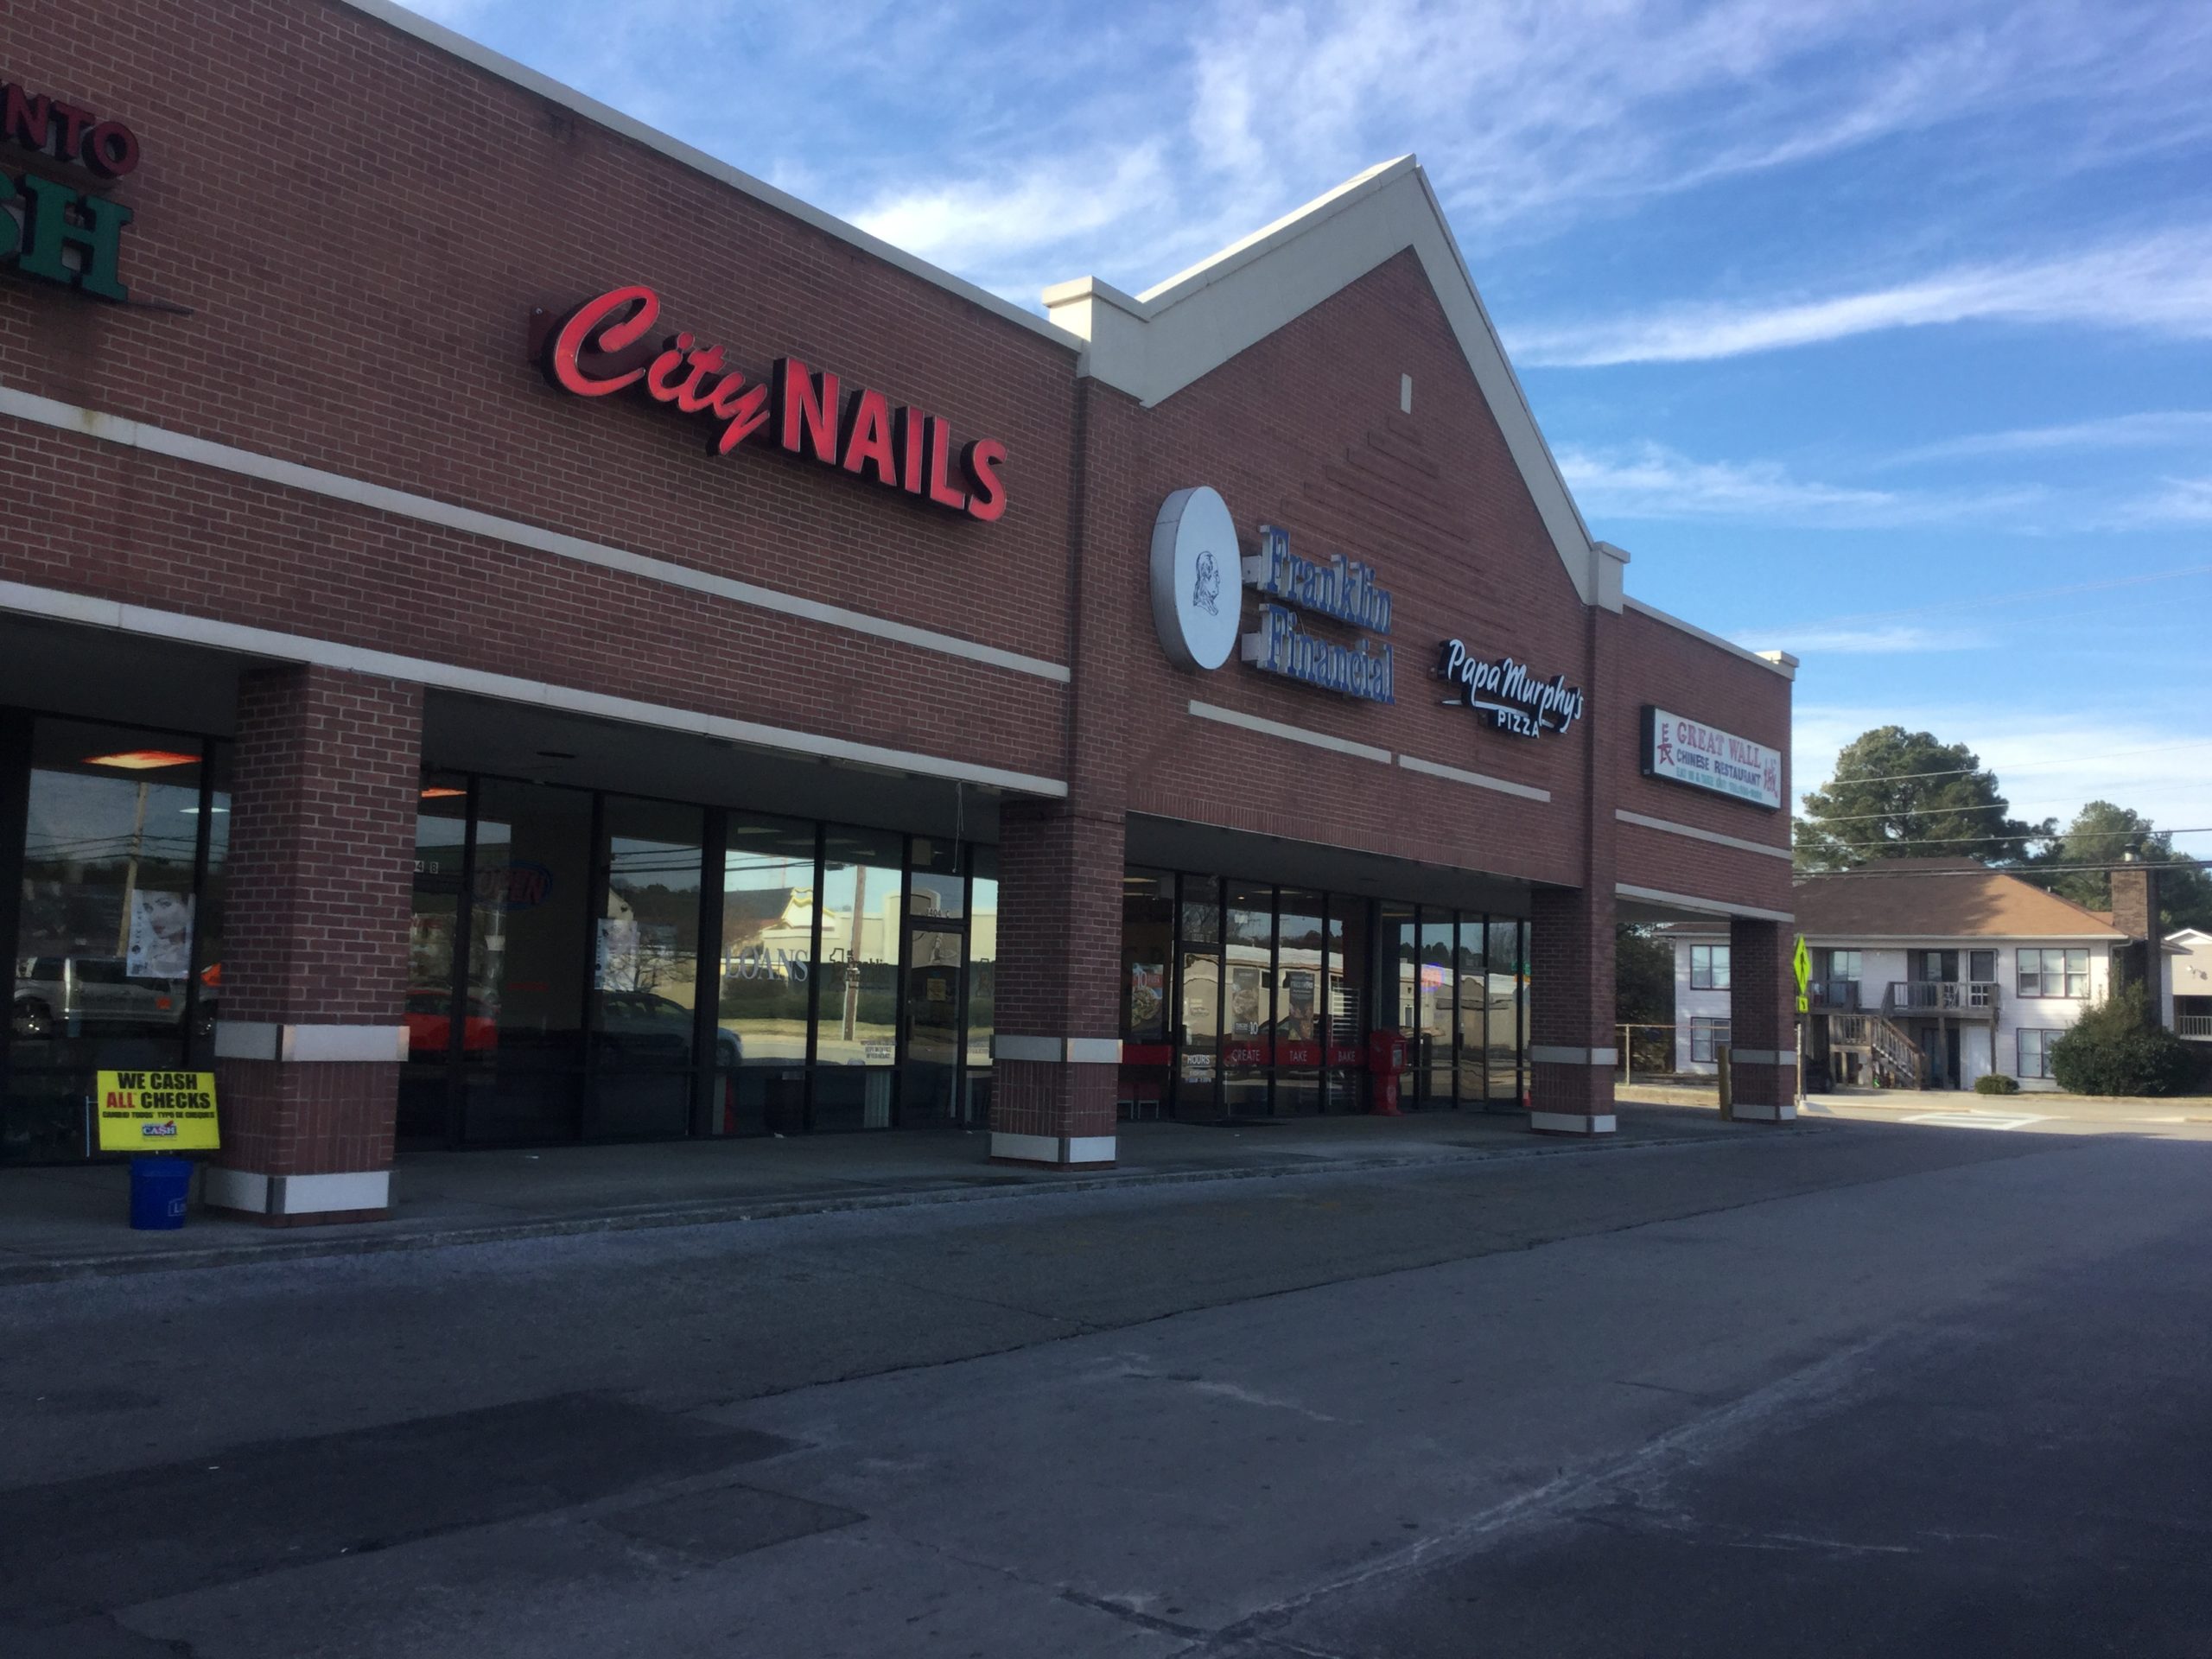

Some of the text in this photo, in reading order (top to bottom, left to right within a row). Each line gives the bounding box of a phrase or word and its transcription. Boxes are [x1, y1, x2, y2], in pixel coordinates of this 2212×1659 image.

[546, 285, 1007, 522] City NAILS
[1258, 524, 1393, 636] Franklin
[1258, 603, 1395, 705] Financial
[1447, 639, 1585, 734] Papa Murphy's
[1497, 709, 1540, 739] PIZZA
[1676, 721, 1761, 769] GREAT WALL
[1676, 748, 1761, 787] CHINESE RESTAURANT
[725, 945, 809, 982] LOANS
[1186, 1054, 1211, 1065] HOURS
[1231, 1049, 1356, 1062] CREATE TAKE BAKE
[106, 1091, 211, 1109] ALL CHECKS
[118, 1072, 198, 1090] WE CASH
